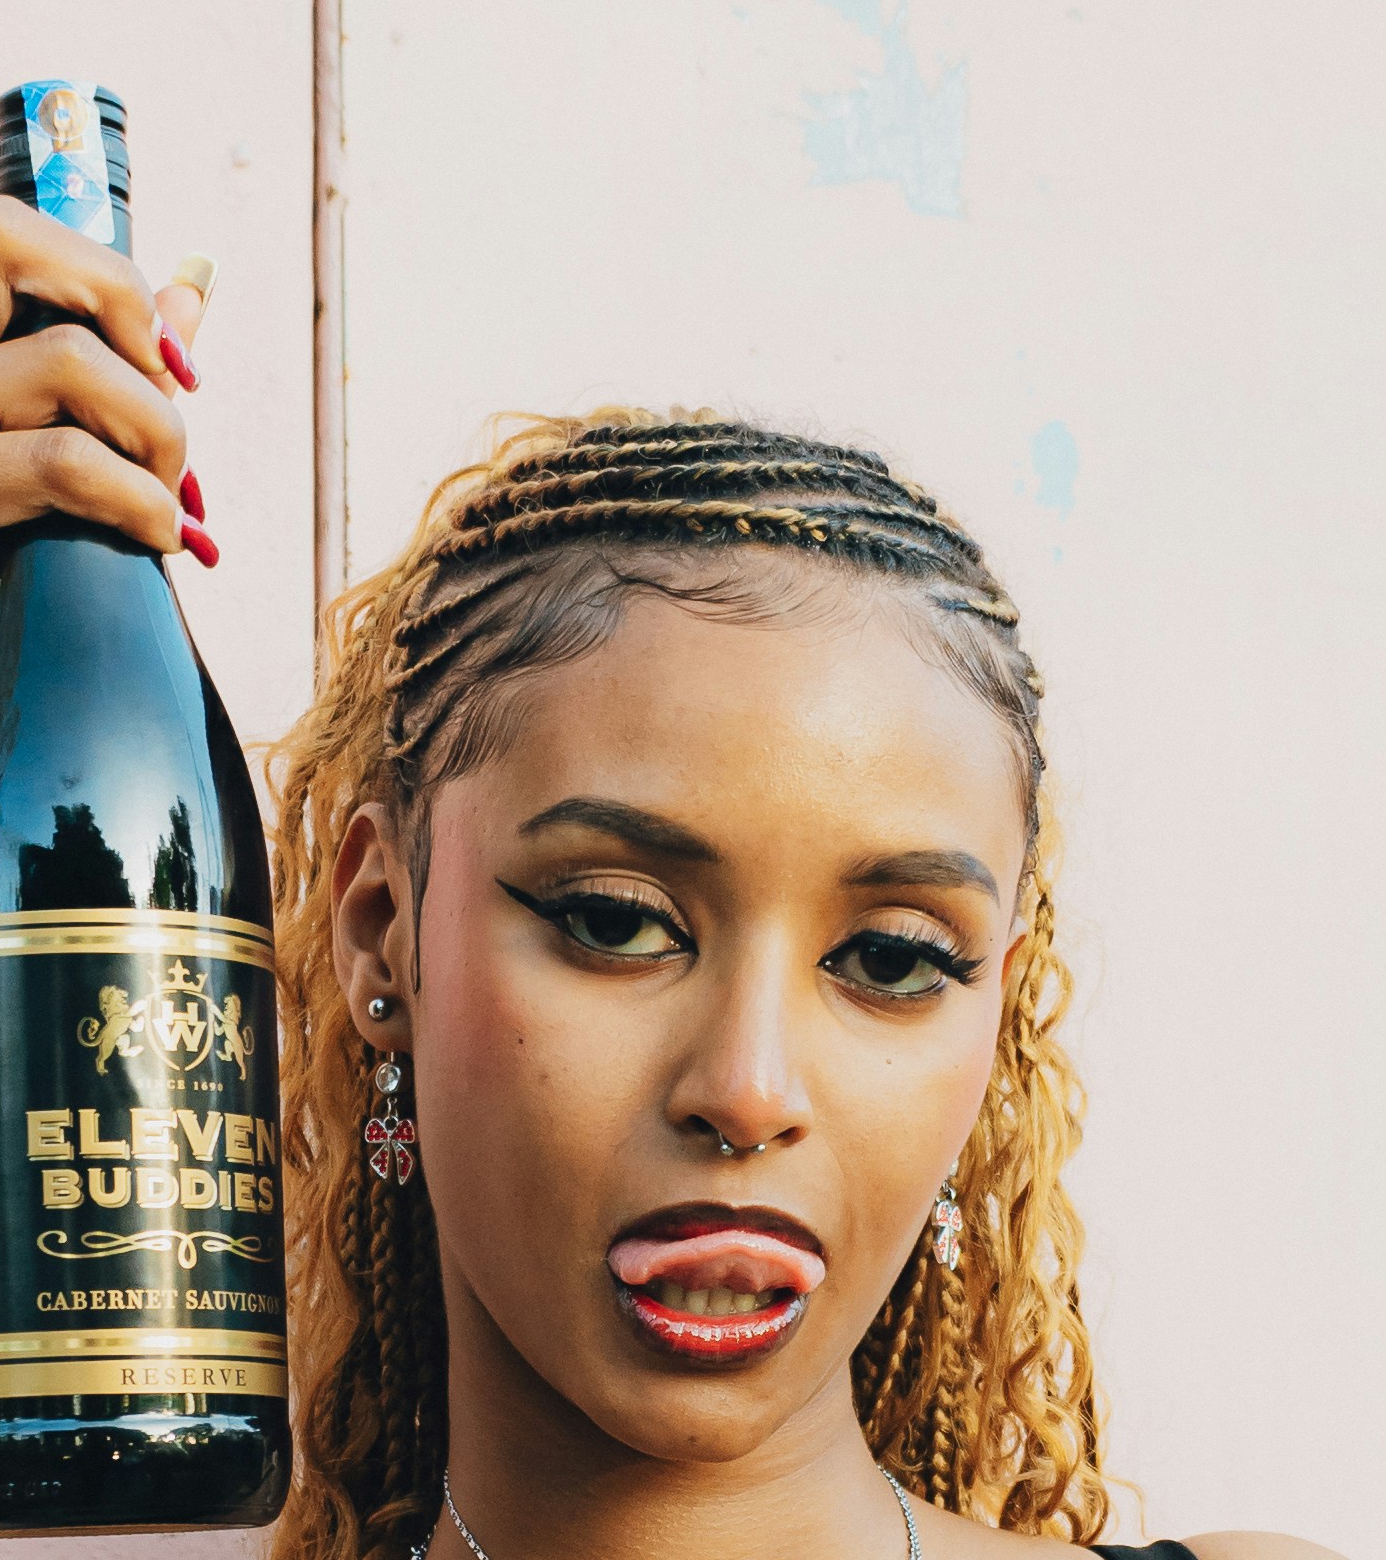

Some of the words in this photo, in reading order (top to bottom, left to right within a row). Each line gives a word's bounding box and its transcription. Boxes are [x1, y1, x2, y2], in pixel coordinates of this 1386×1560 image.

[25, 1107, 277, 1166] ELEVEN
[41, 1166, 274, 1214] BUDDIES
[36, 1289, 178, 1312] CABERNET
[120, 1367, 247, 1387] RESERVE
